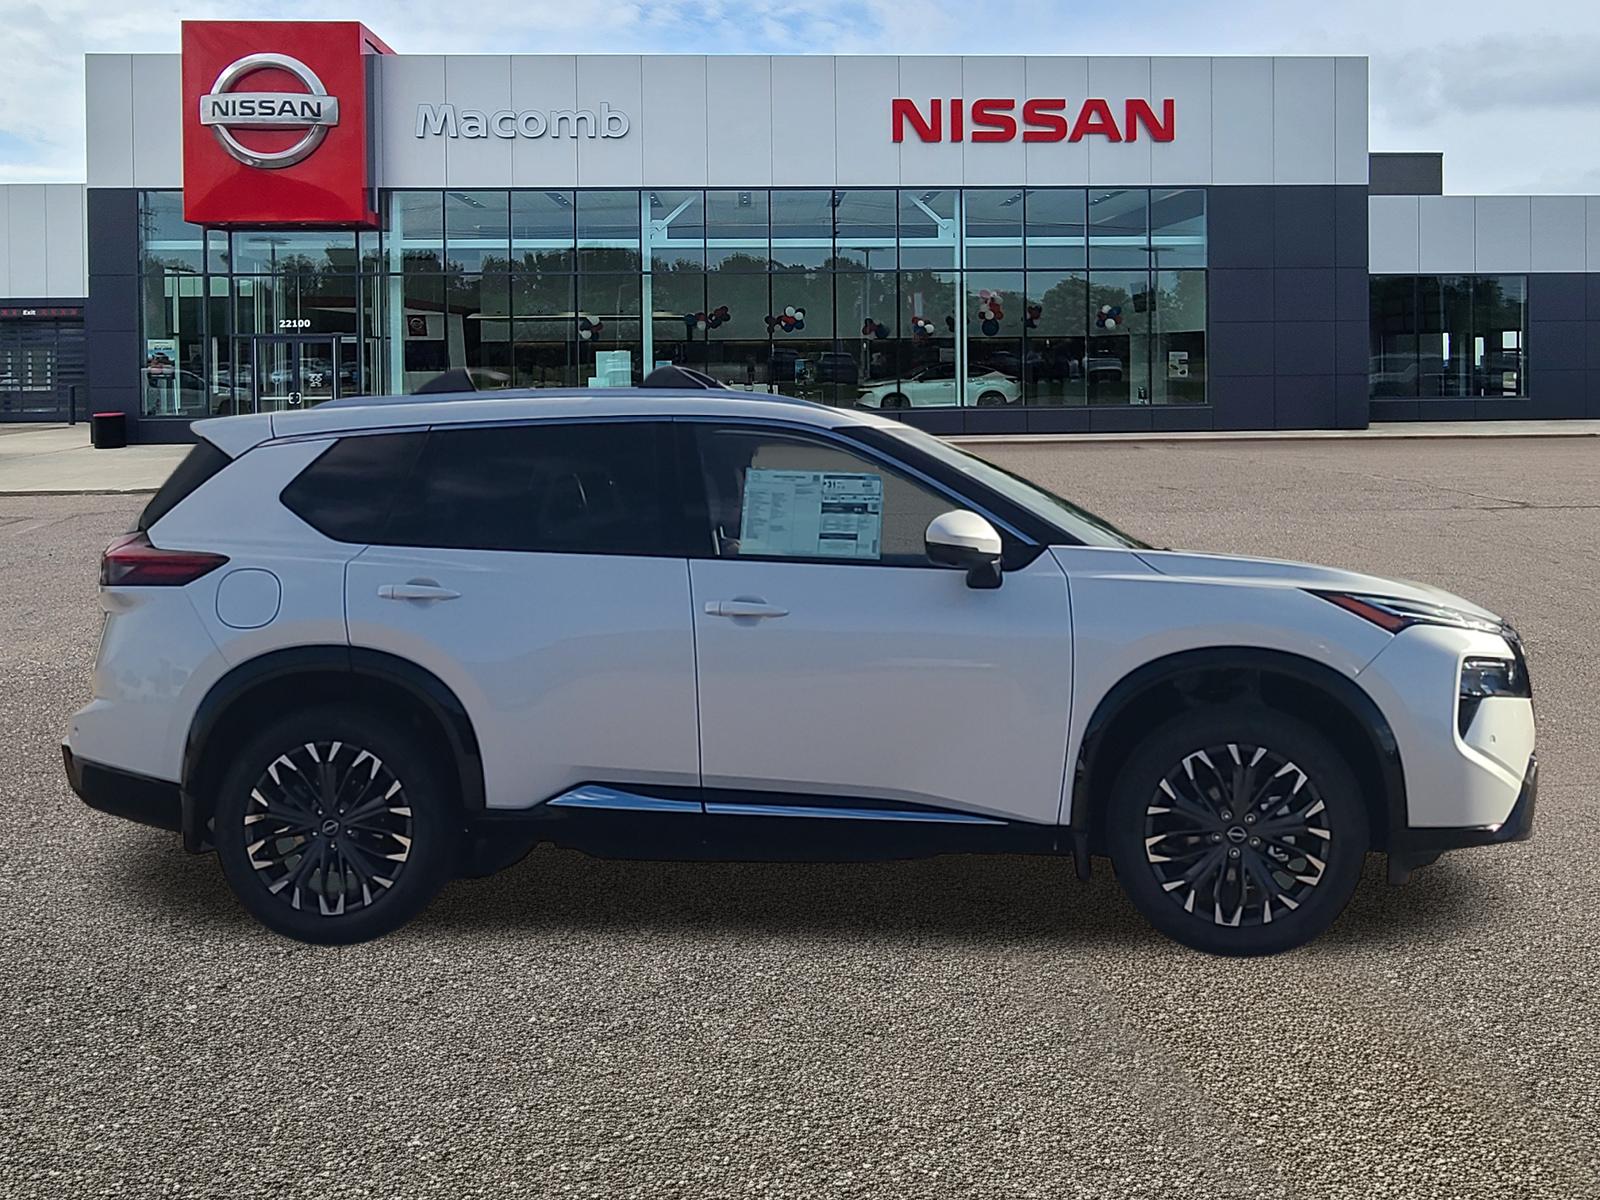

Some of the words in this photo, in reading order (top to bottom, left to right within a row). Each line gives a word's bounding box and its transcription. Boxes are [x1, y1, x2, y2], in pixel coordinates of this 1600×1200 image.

[211, 99, 322, 118] NISSAN
[415, 102, 630, 138] Macomb
[892, 98, 1175, 142] NISSAN
[279, 319, 311, 328] 22100
